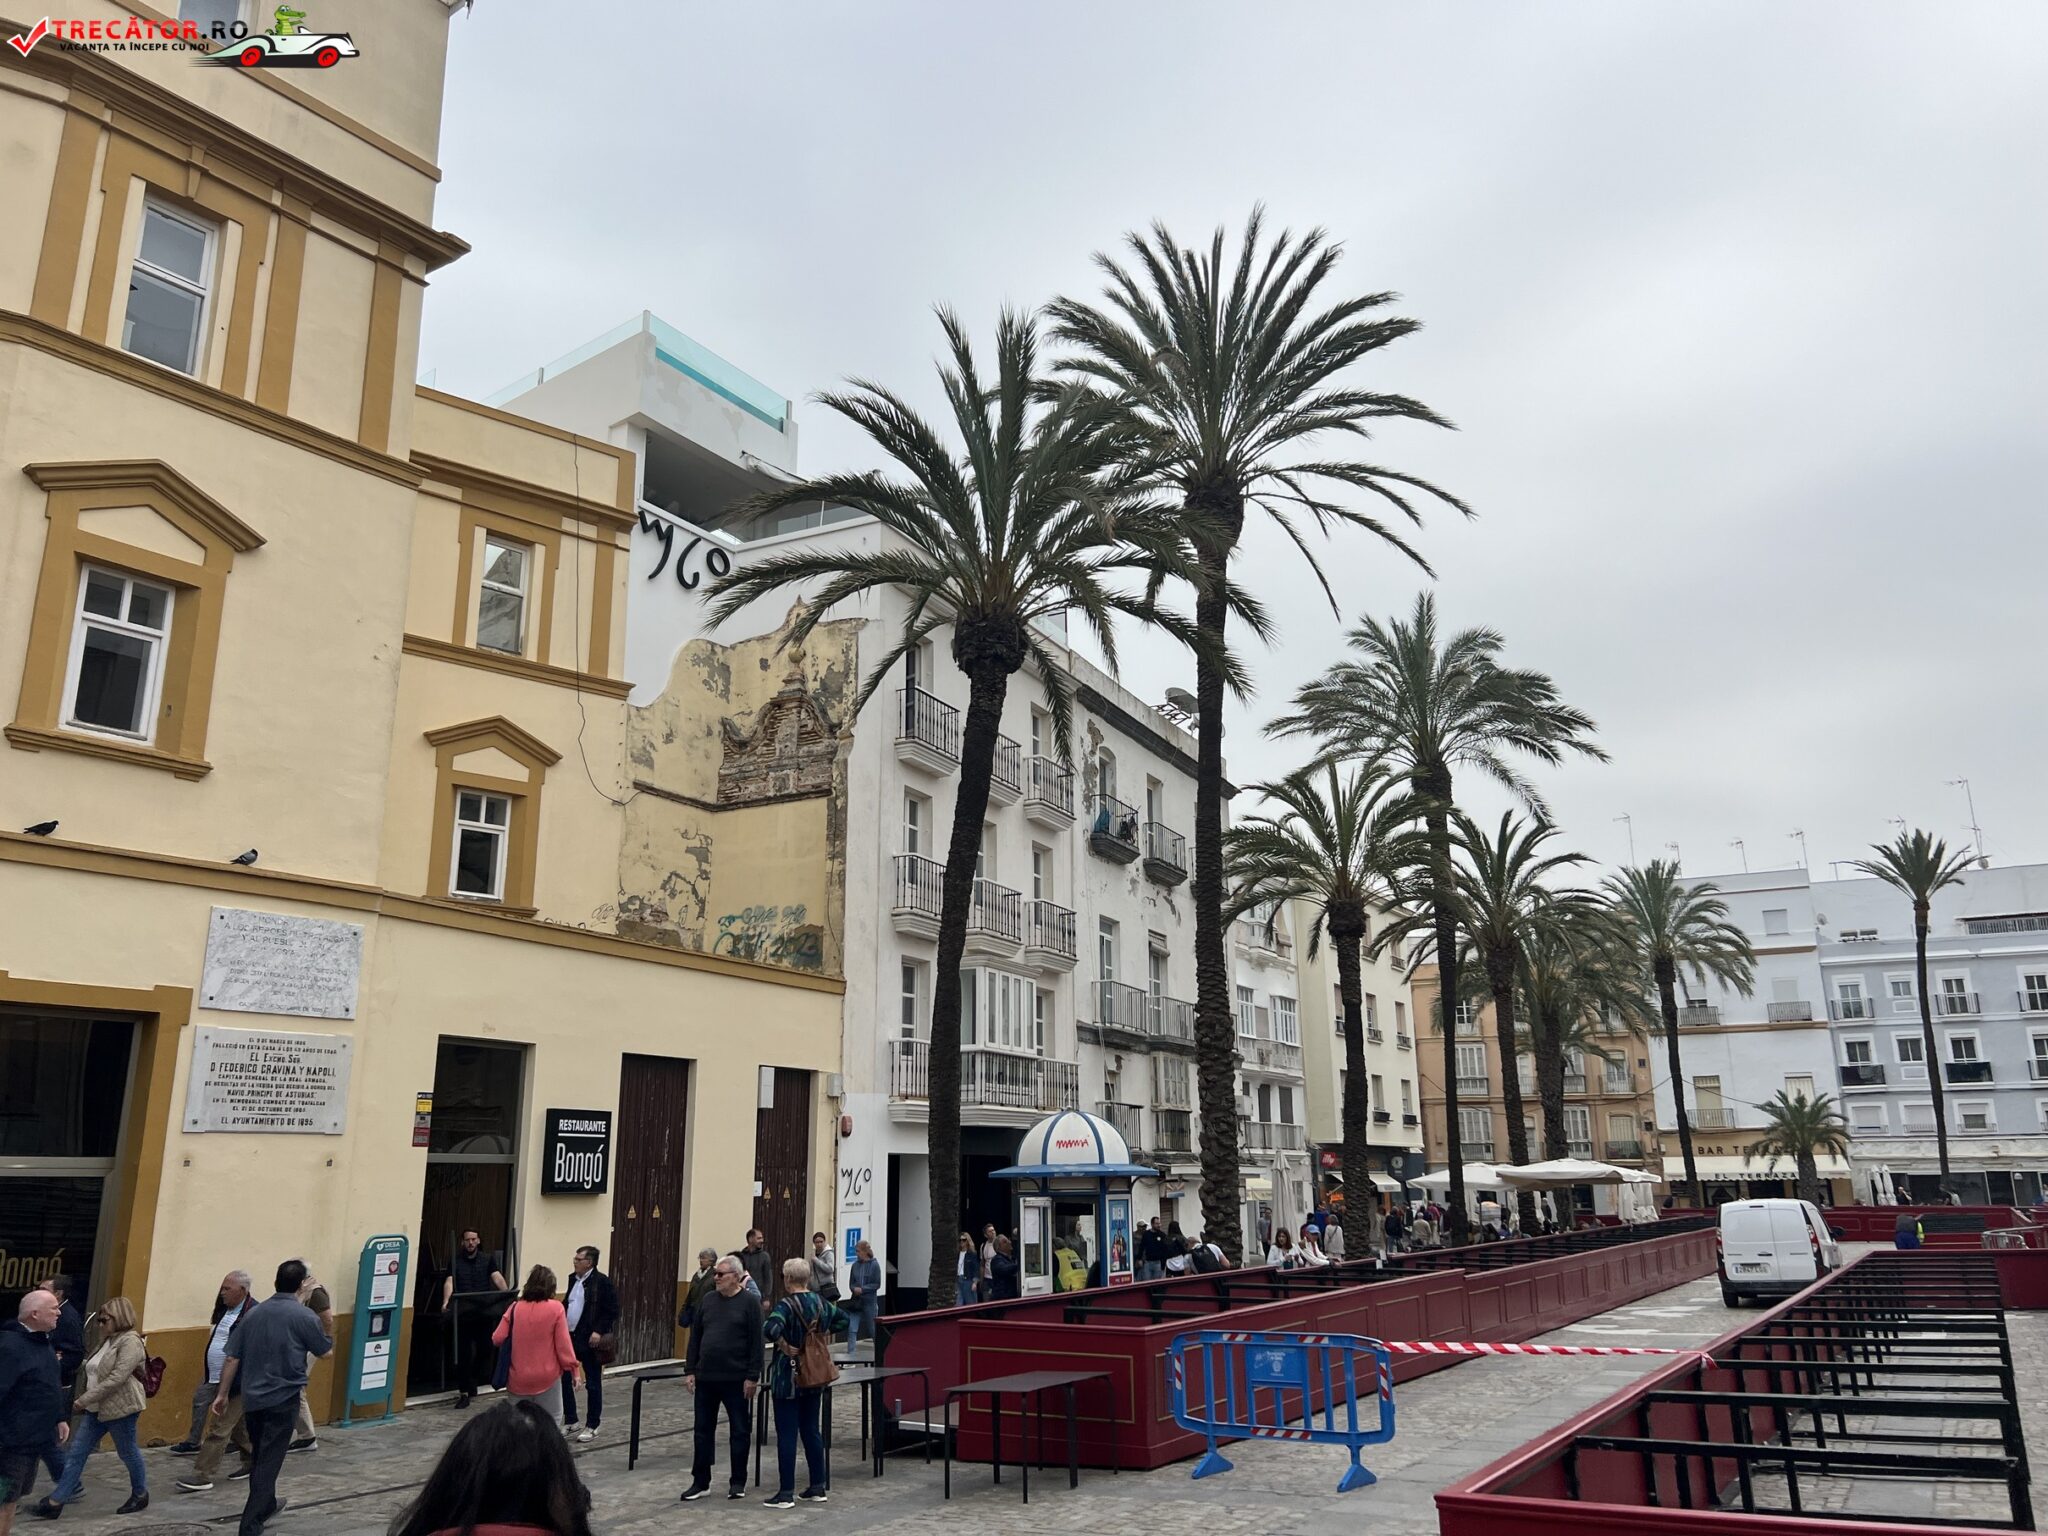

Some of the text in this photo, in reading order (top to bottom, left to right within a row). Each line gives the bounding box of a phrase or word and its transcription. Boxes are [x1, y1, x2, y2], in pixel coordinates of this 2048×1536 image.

[250, 1052, 259, 1062] EL
[219, 1062, 258, 1073] FEDERICO
[261, 1064, 297, 1075] GRAVINA
[299, 1066, 305, 1075] Y
[221, 1116, 229, 1124] EL
[232, 1117, 285, 1126] AYUNTAMIENTO
[287, 1118, 296, 1126] DE
[559, 1119, 606, 1133] RESTAURANTE
[1697, 1146, 1724, 1155] BAR
[554, 1142, 605, 1190] Bongó
[1739, 1171, 1796, 1179] TERRAZA
